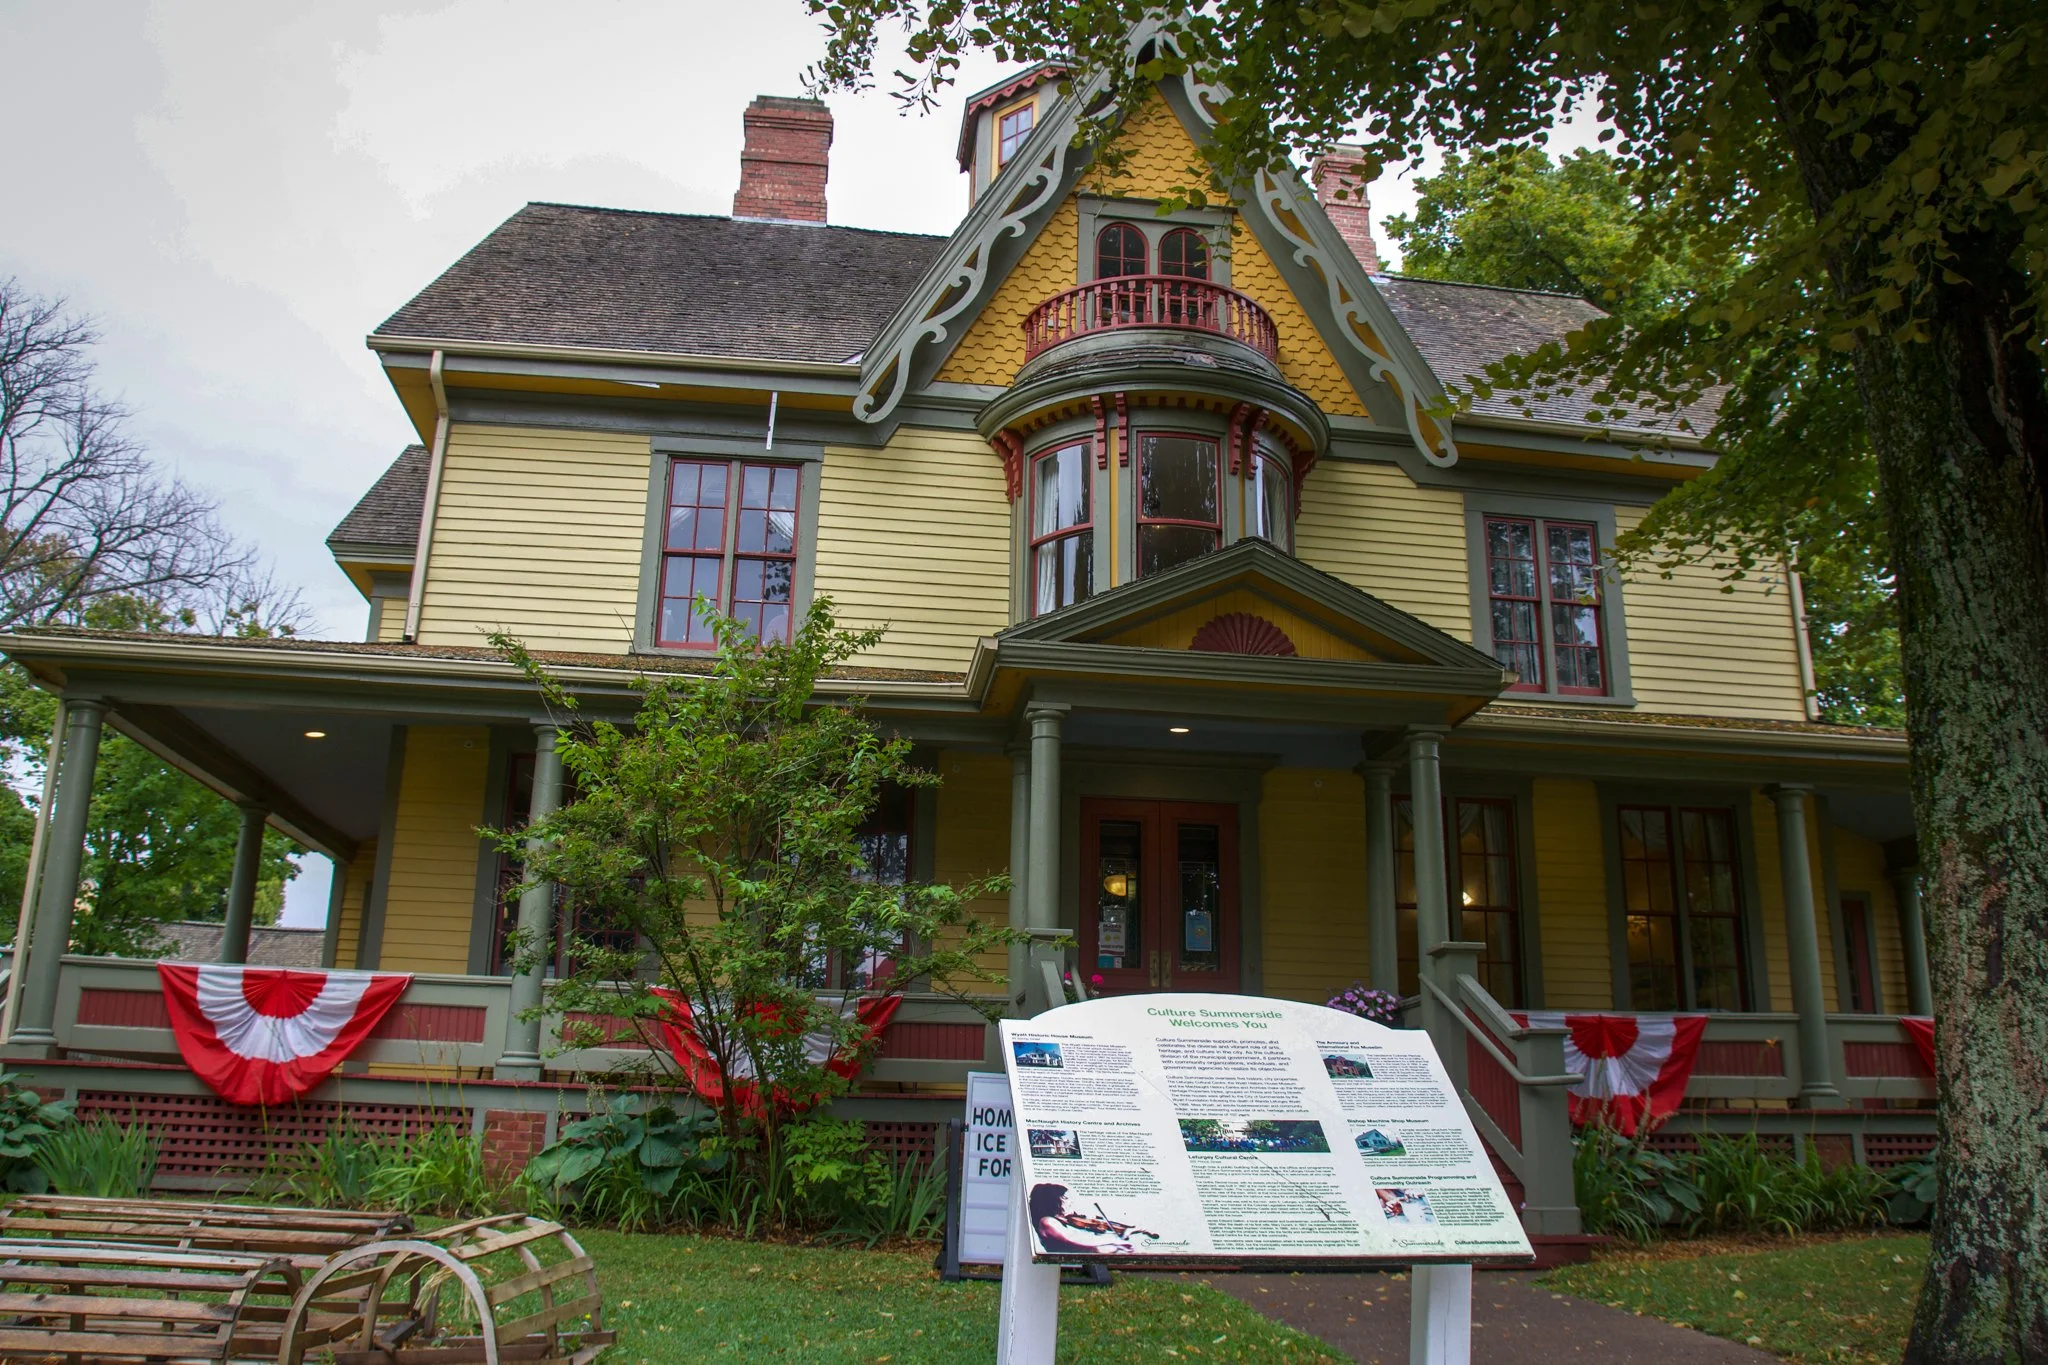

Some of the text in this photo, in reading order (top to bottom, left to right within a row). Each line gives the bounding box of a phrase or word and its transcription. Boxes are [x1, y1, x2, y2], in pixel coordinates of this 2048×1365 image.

[1147, 1007, 1282, 1018] Culture Summerside
[1169, 1018, 1267, 1029] Welcomes You
[973, 1107, 1012, 1128] HOM
[977, 1133, 1006, 1152] ICE
[979, 1158, 1011, 1177] FOR
